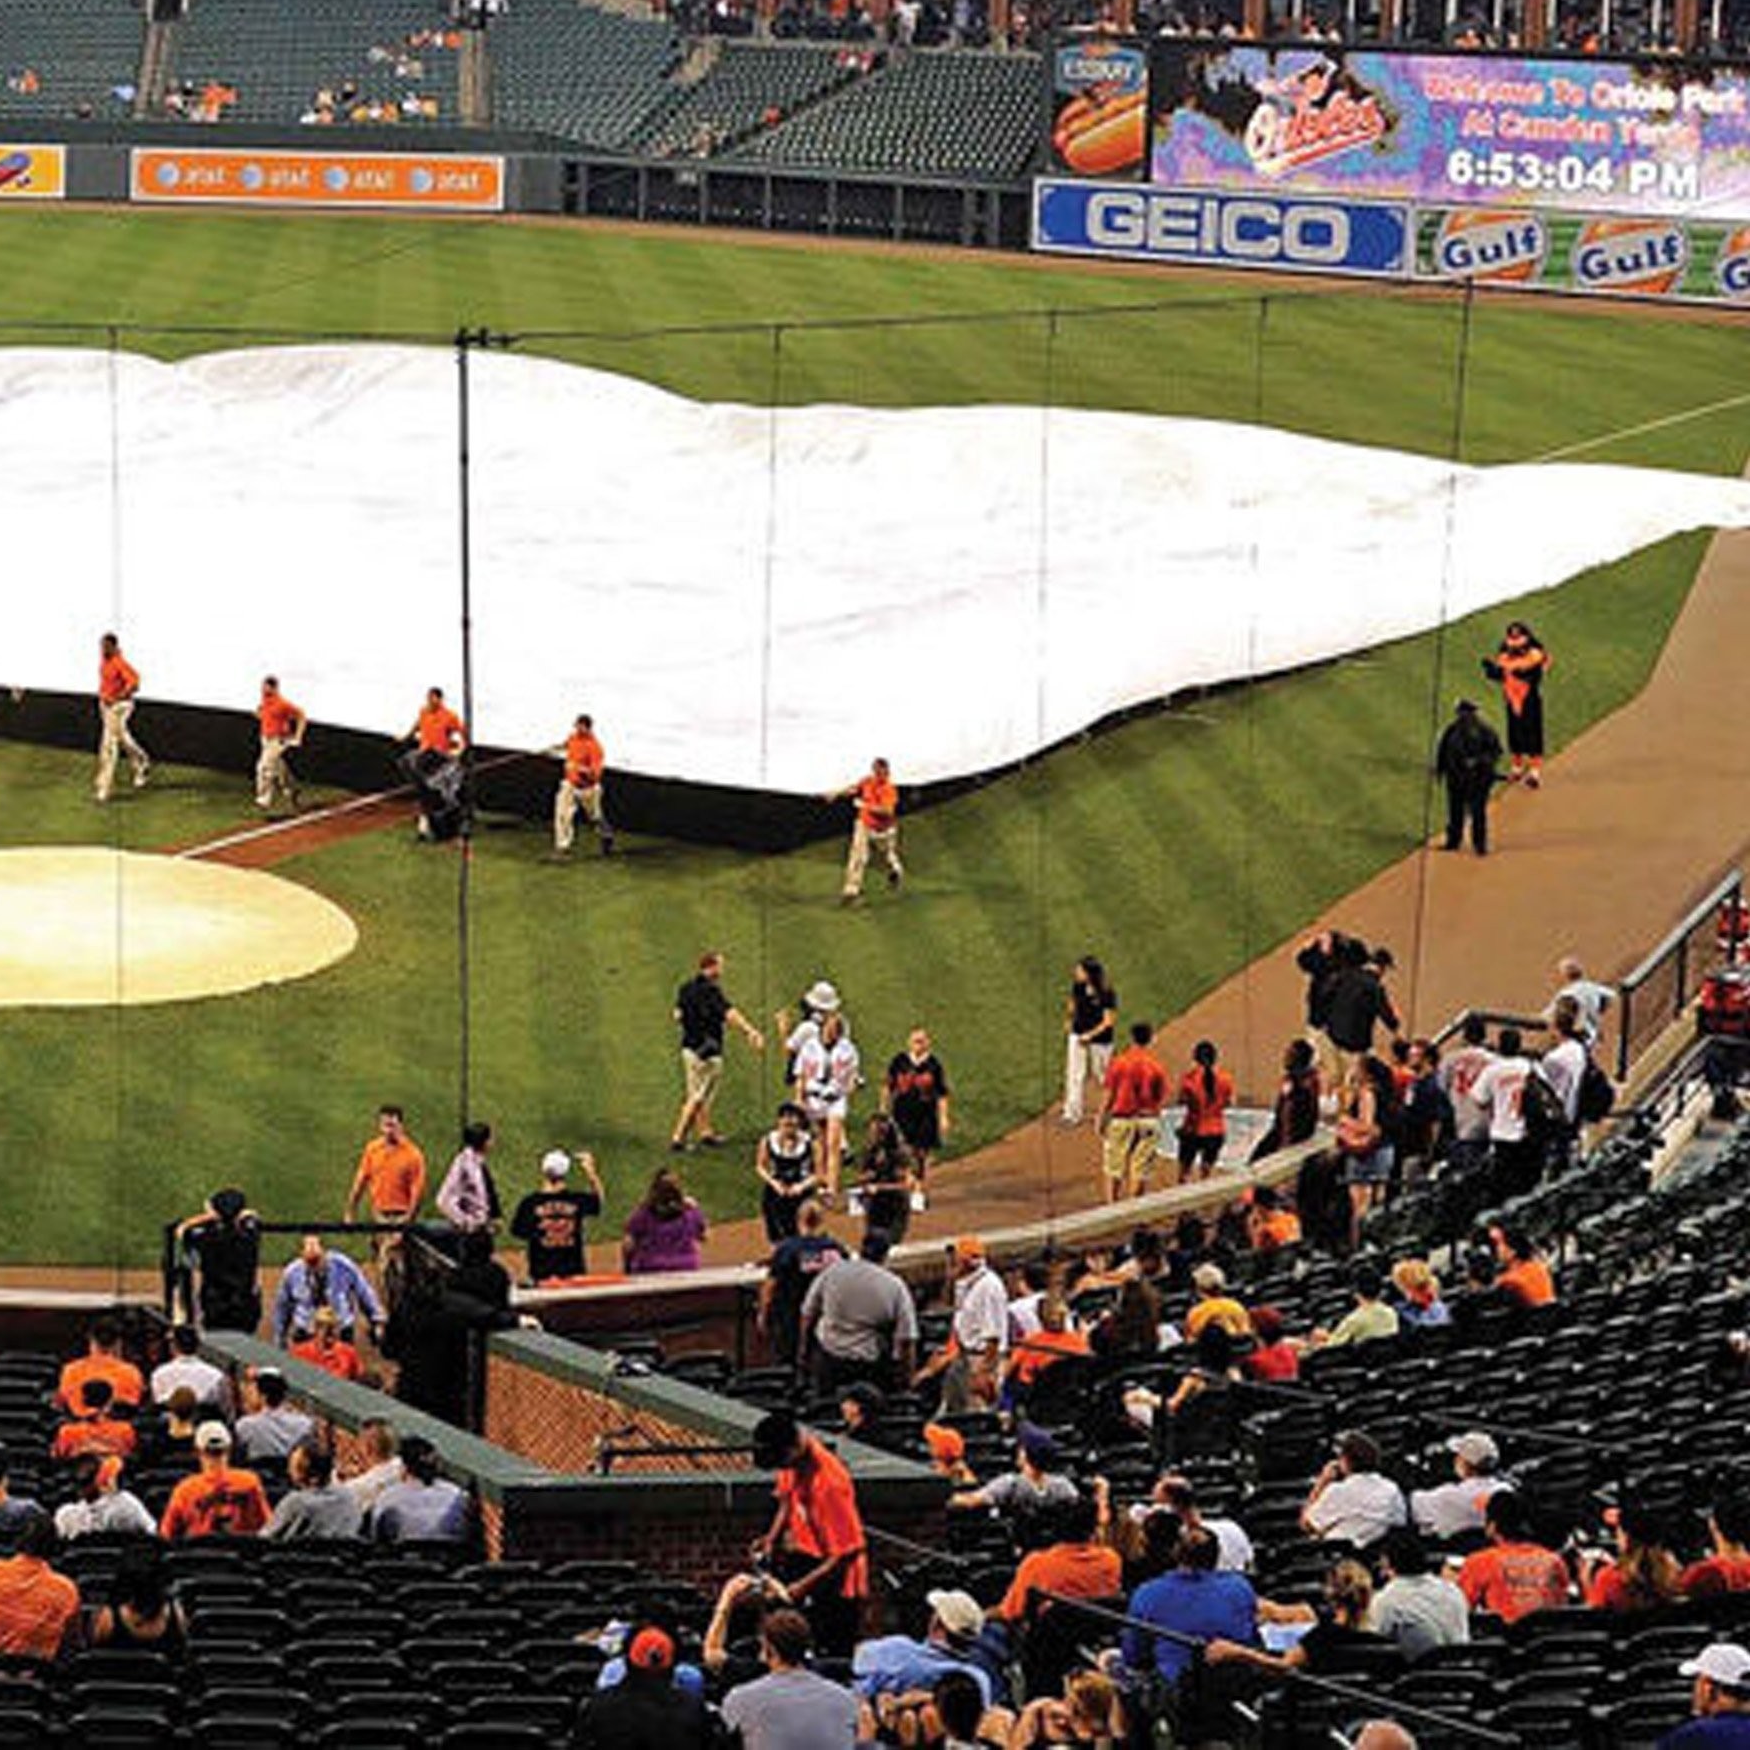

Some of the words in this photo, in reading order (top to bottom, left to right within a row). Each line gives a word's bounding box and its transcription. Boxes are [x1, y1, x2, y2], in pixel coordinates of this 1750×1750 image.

[1449, 151, 1613, 192] 6:53:04
[1629, 161, 1699, 199] PM
[1085, 191, 1350, 262] GEICO
[1443, 224, 1538, 268] Gulf
[1580, 234, 1681, 279] Gulf
